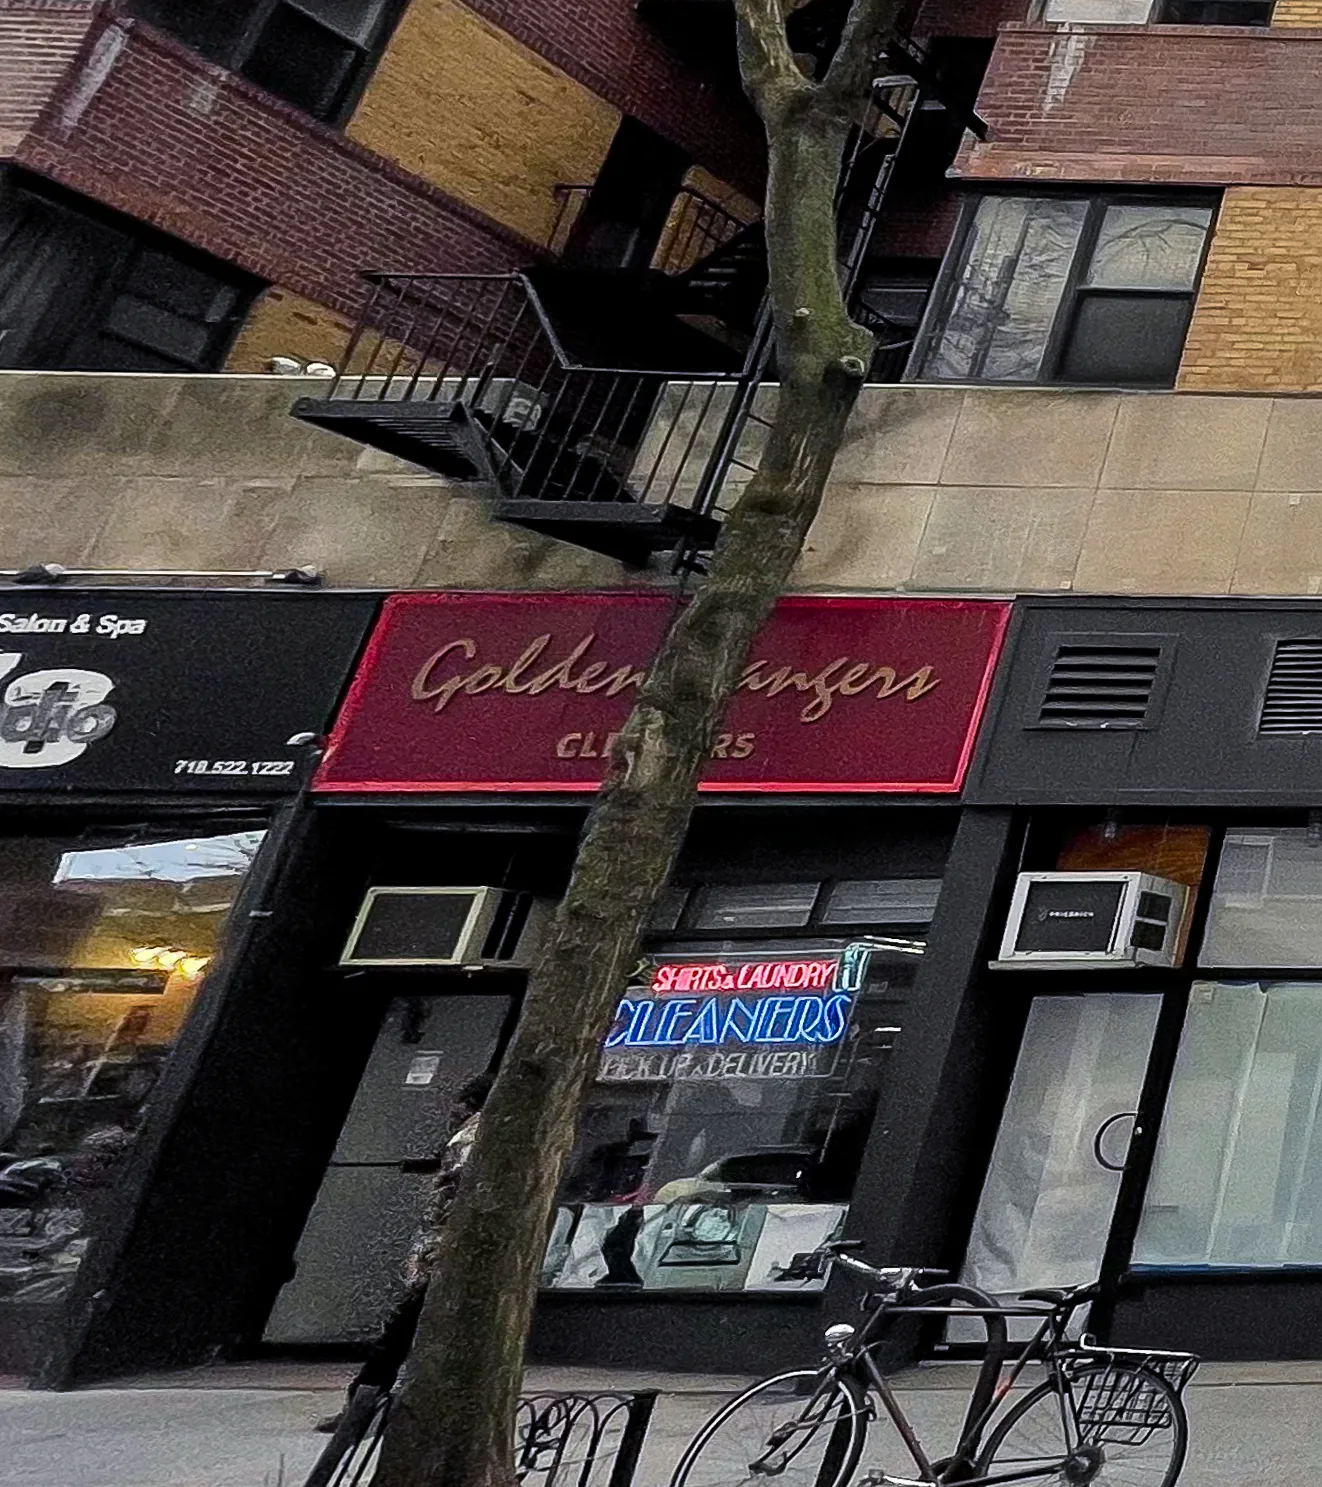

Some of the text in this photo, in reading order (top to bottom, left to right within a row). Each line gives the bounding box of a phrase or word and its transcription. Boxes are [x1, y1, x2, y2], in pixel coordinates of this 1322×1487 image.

[0, 613, 148, 640] Salon & Spa
[411, 633, 942, 723] Golden angers
[652, 965, 726, 992] SHIRTS
[736, 961, 838, 989] LAUNDRY
[604, 993, 852, 1048] CLEANERS
